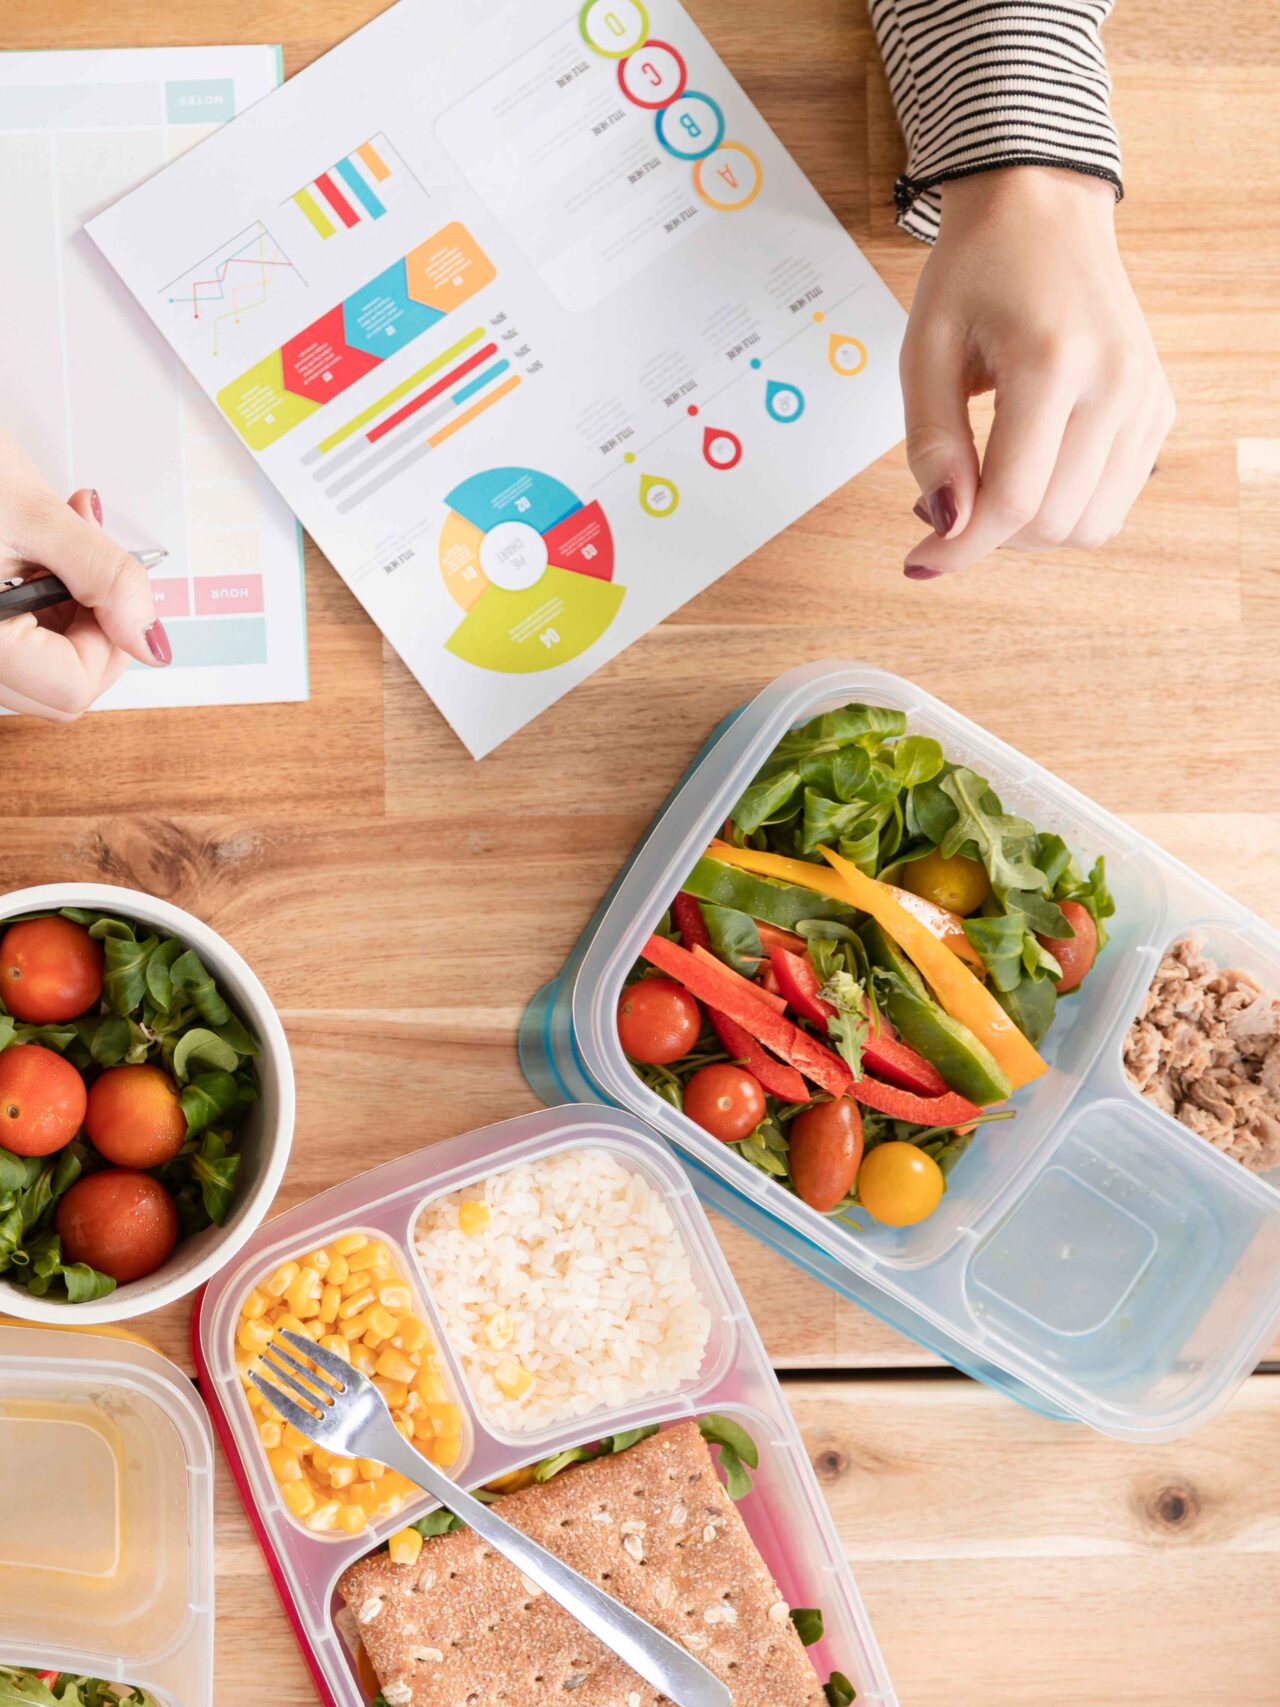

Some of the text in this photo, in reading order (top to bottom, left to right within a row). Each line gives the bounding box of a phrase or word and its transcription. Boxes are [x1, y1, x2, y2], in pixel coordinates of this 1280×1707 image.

[604, 12, 626, 37] D
[642, 63, 662, 86] C
[680, 113, 702, 138] B
[717, 164, 738, 189] A
[515, 497, 531, 512] 02
[496, 538, 524, 563] CHART
[581, 544, 597, 559] 03
[211, 587, 249, 600] HOUR
[540, 628, 560, 648] 04
